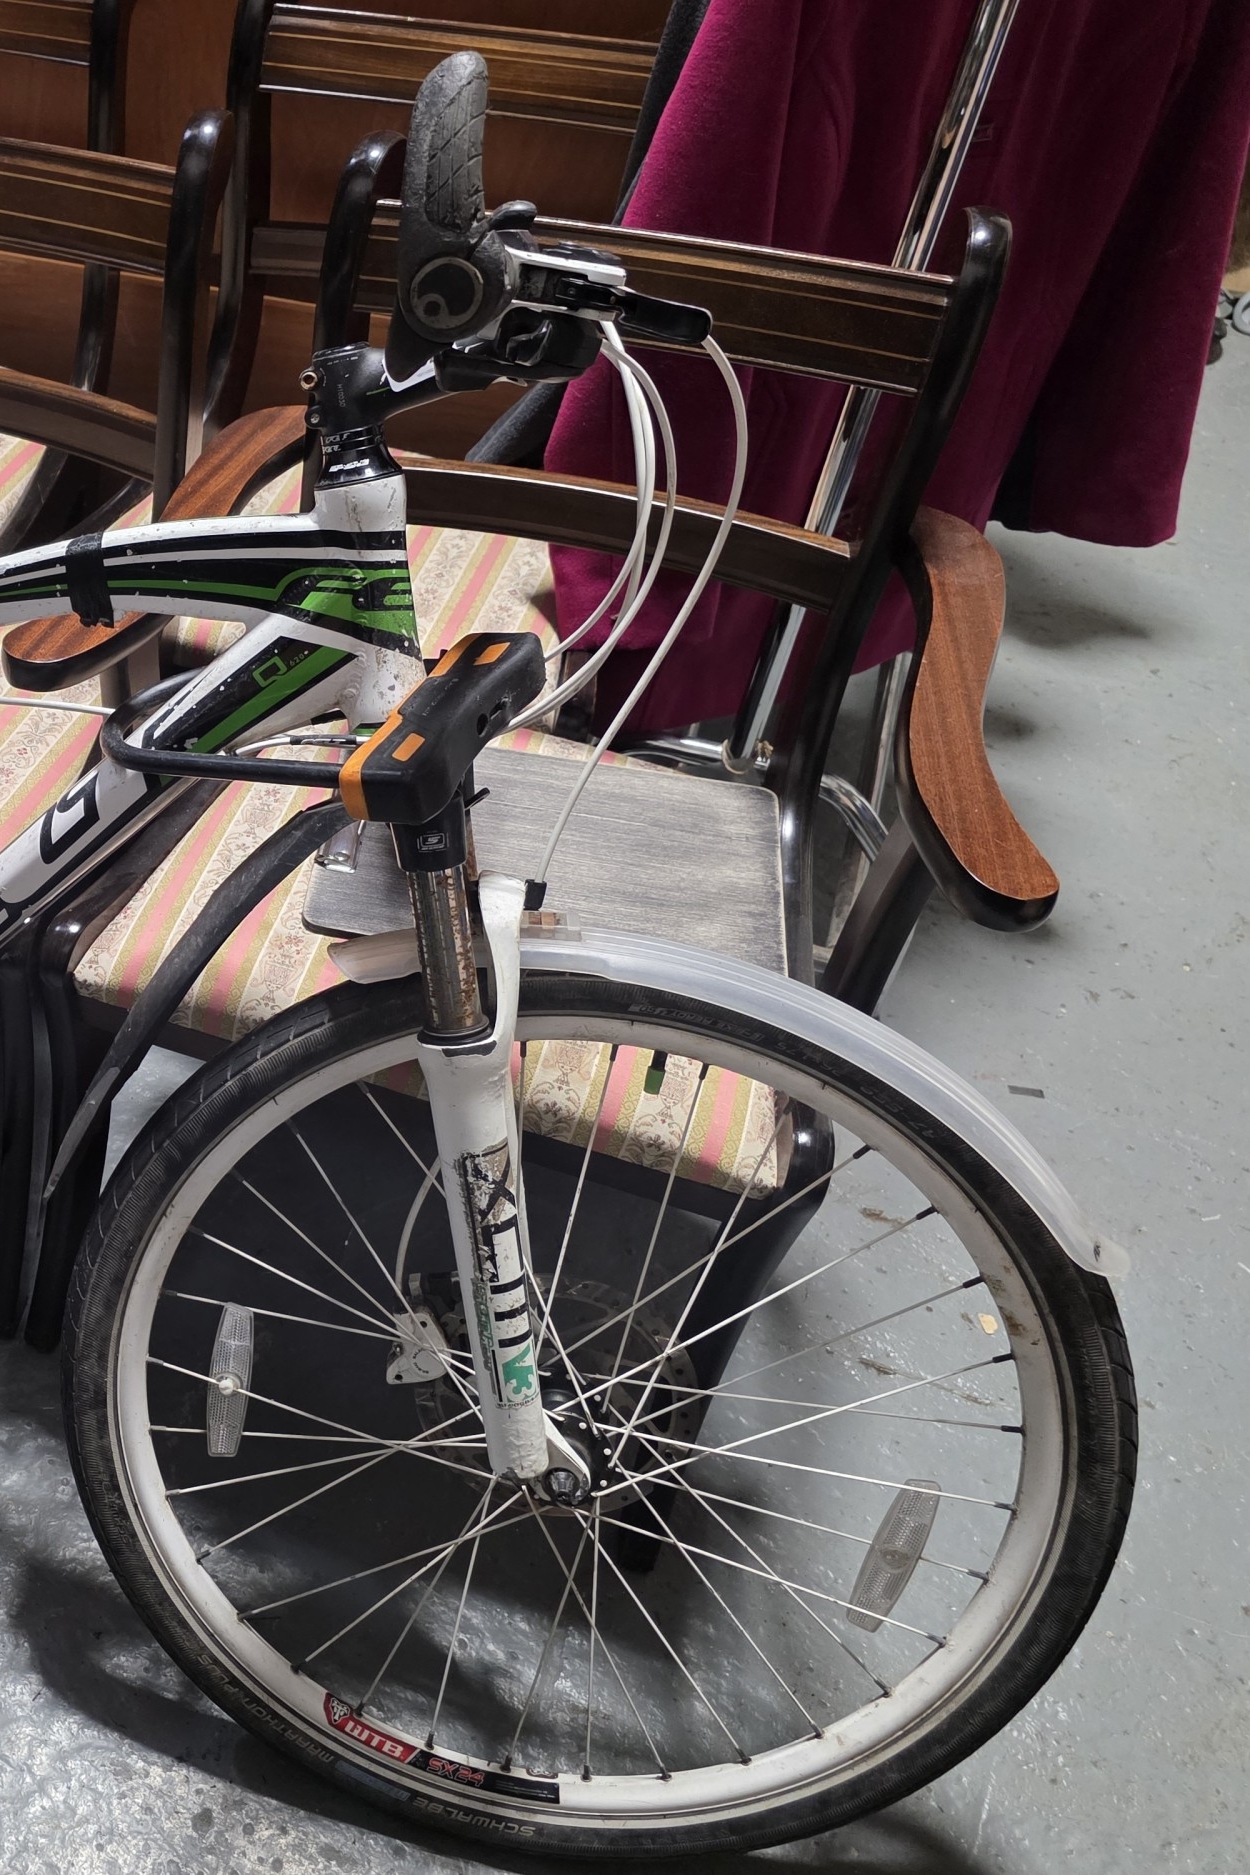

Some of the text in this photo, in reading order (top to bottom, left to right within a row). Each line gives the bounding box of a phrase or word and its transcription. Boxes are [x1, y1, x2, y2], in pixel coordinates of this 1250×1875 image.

[195, 1653, 334, 1764] MARATHON PLUS
[344, 1719, 406, 1758] WTB
[427, 1757, 485, 1787] SX24
[413, 1796, 536, 1836] SCHWALBE
